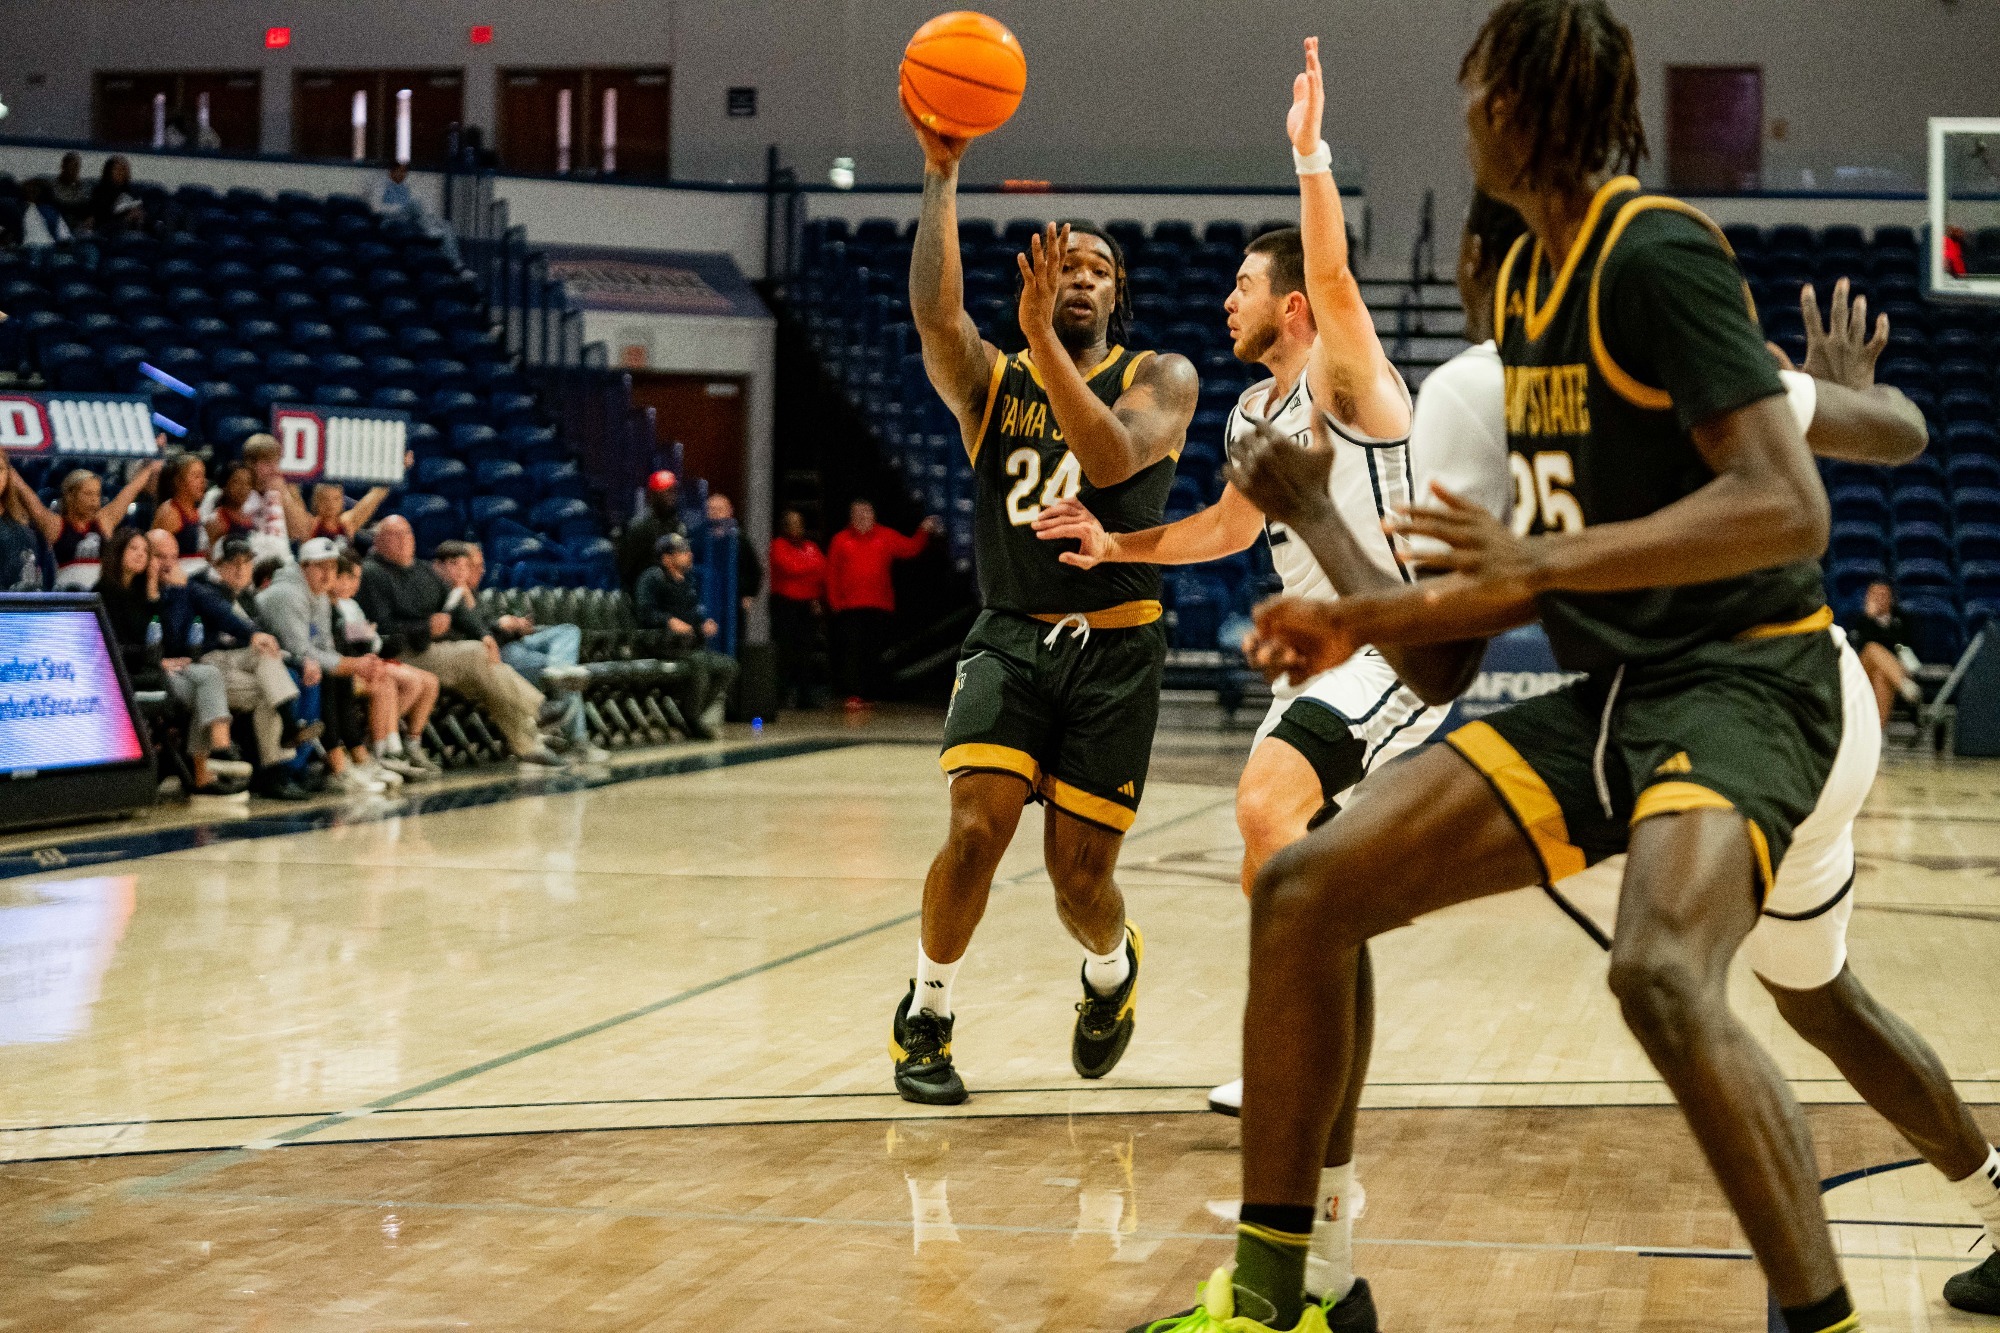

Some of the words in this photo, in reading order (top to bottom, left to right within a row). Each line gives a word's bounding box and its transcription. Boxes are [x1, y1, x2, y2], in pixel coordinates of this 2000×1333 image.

[0, 400, 44, 448] D
[280, 416, 320, 473] D
[1006, 447, 1081, 526] 24
